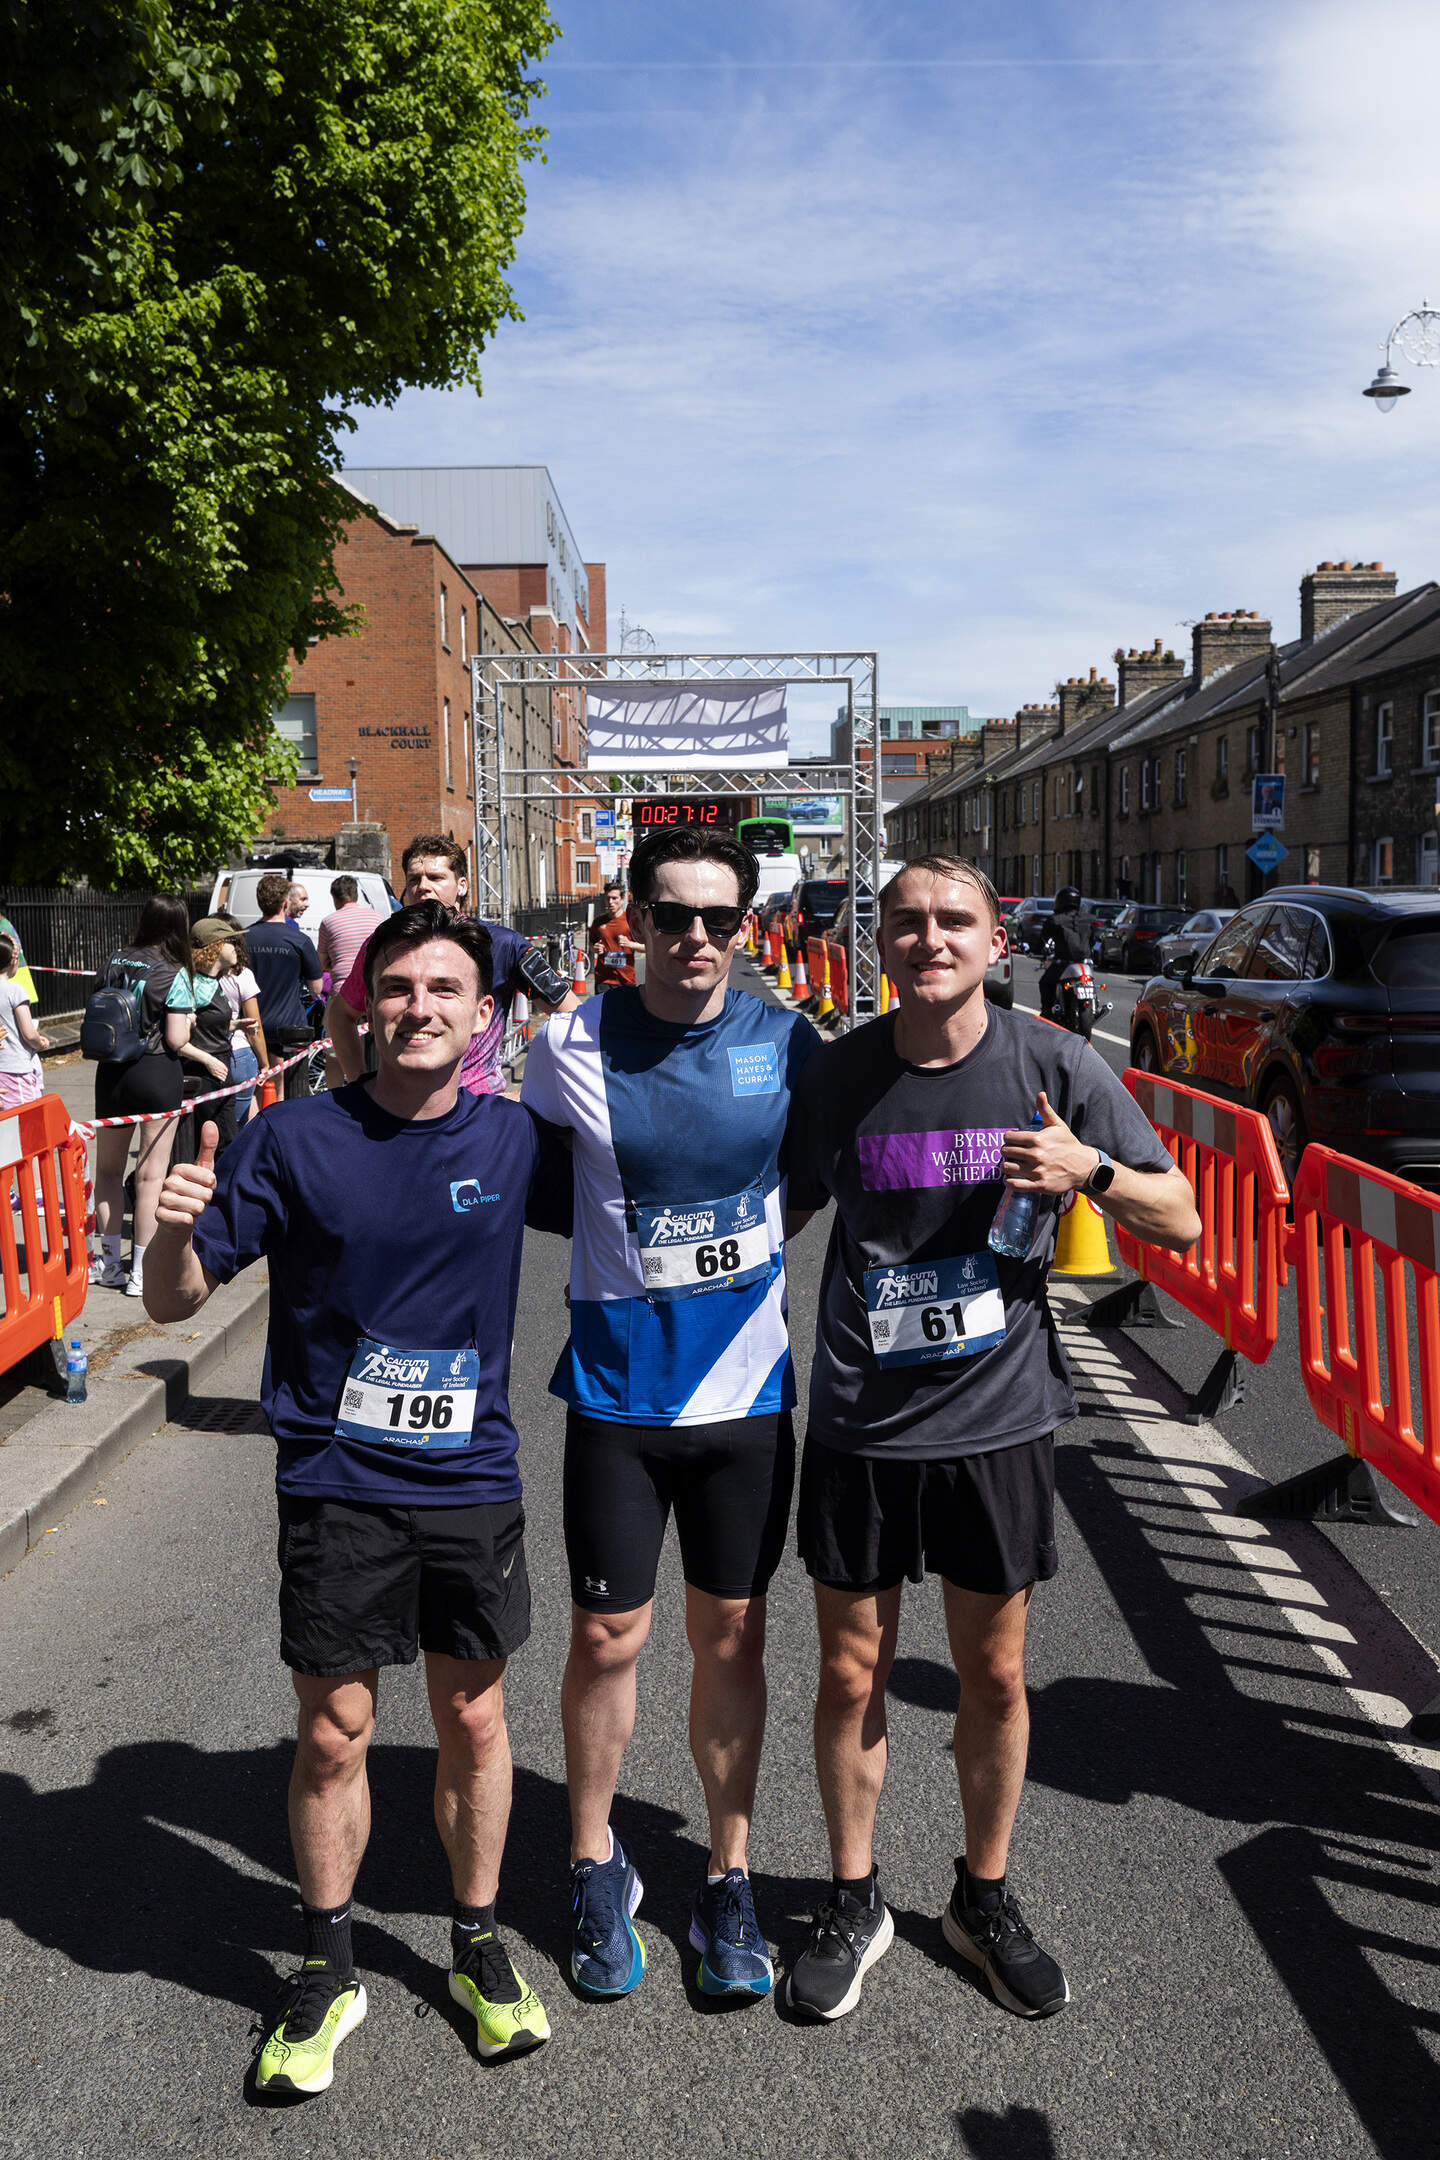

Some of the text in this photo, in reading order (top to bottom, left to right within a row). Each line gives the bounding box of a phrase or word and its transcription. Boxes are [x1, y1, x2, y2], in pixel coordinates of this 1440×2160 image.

[359, 726, 431, 736] BLACKHALL
[391, 739, 431, 749] COURT
[641, 805, 718, 824] 00:27:12
[274, 947, 290, 956] FRY
[736, 1055, 768, 1064] MASON
[738, 1074, 774, 1084] CURRAN
[932, 1148, 1001, 1166] WALLAC
[942, 1166, 1002, 1182] SHIELD
[462, 1194, 500, 1206] DLA PIPER
[672, 1211, 714, 1222] CALCUTTA
[673, 1217, 715, 1237] RUN
[696, 1239, 741, 1277] 68
[896, 1270, 936, 1282] CALCUTTA
[692, 1282, 728, 1294] ARACHAS
[897, 1277, 938, 1298] RUN
[921, 1302, 966, 1342] 61
[920, 1348, 959, 1359] ARACHAS
[386, 1357, 429, 1366] CALCUTTA
[382, 1365, 429, 1382] RUN
[387, 1394, 453, 1429] 196
[382, 1436, 423, 1445] ARACHAS
[471, 1932, 492, 1943] saucony
